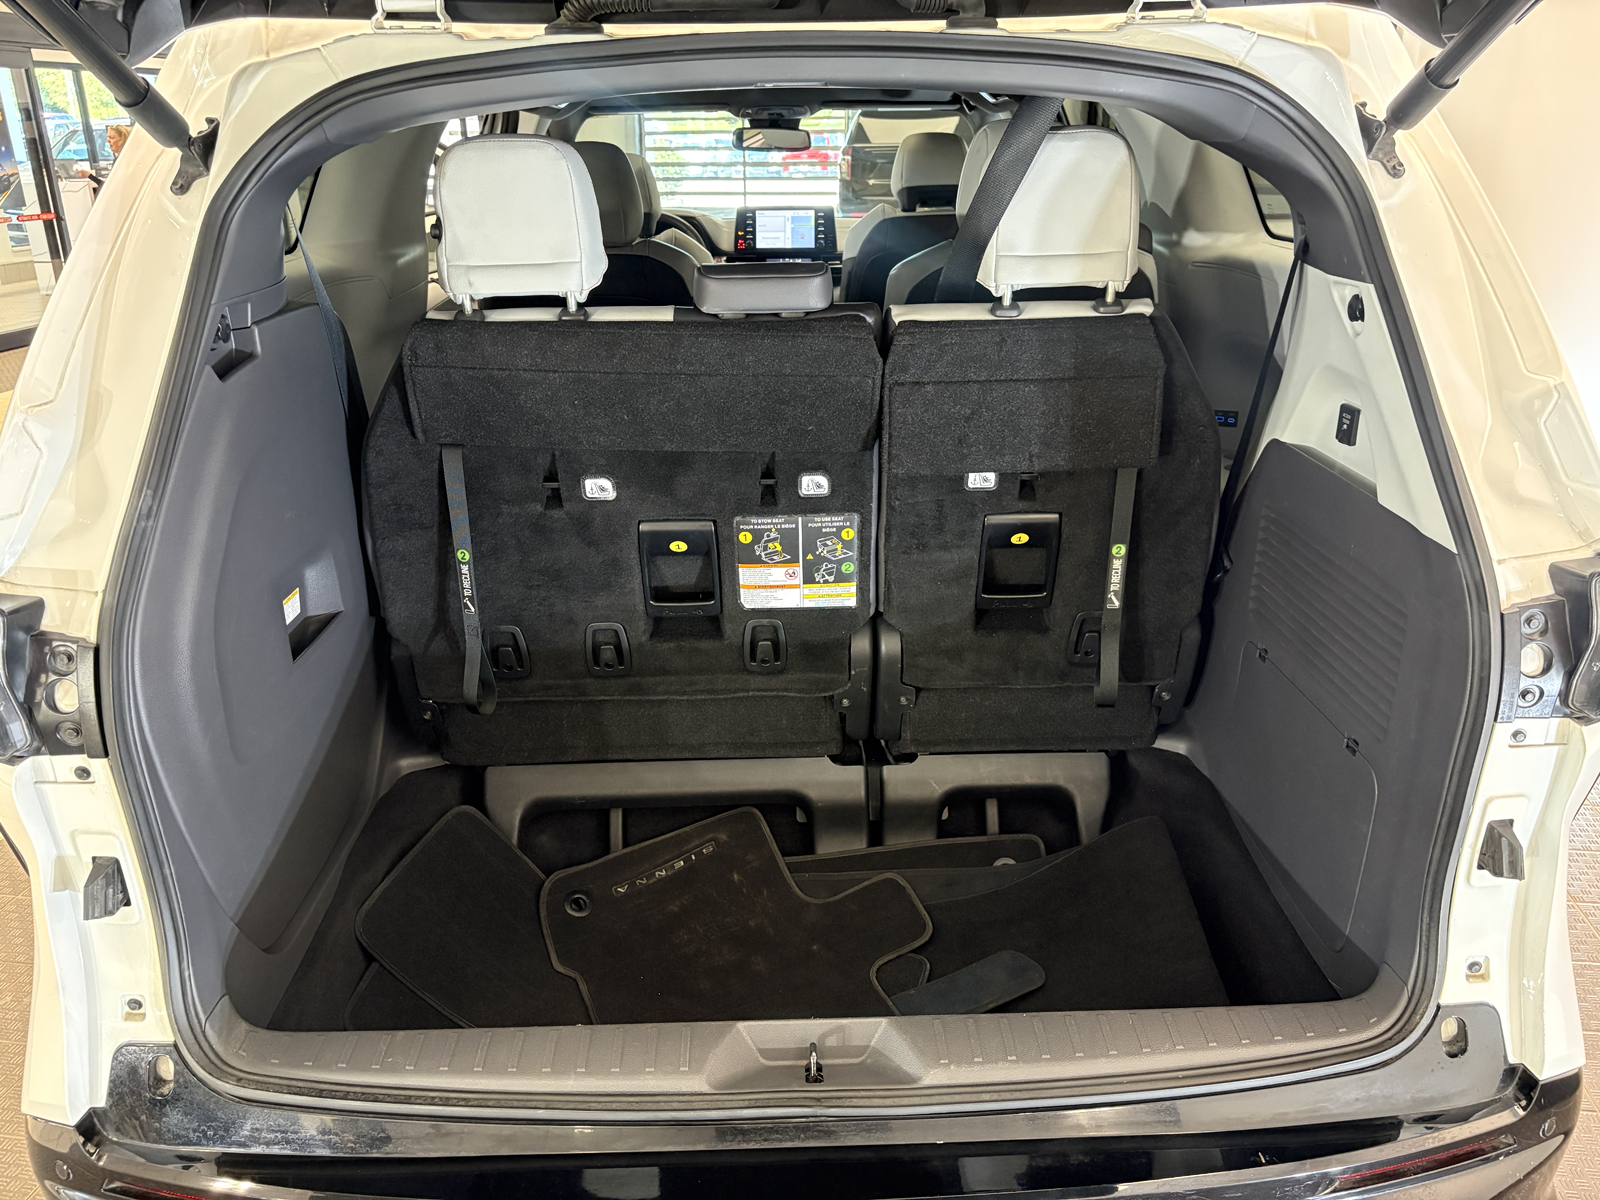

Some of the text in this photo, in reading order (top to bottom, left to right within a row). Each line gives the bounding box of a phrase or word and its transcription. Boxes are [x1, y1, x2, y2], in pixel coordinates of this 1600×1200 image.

[460, 564, 472, 588] RECLINE
[1111, 558, 1122, 583] RECLINE
[617, 846, 713, 893] SIENNA
